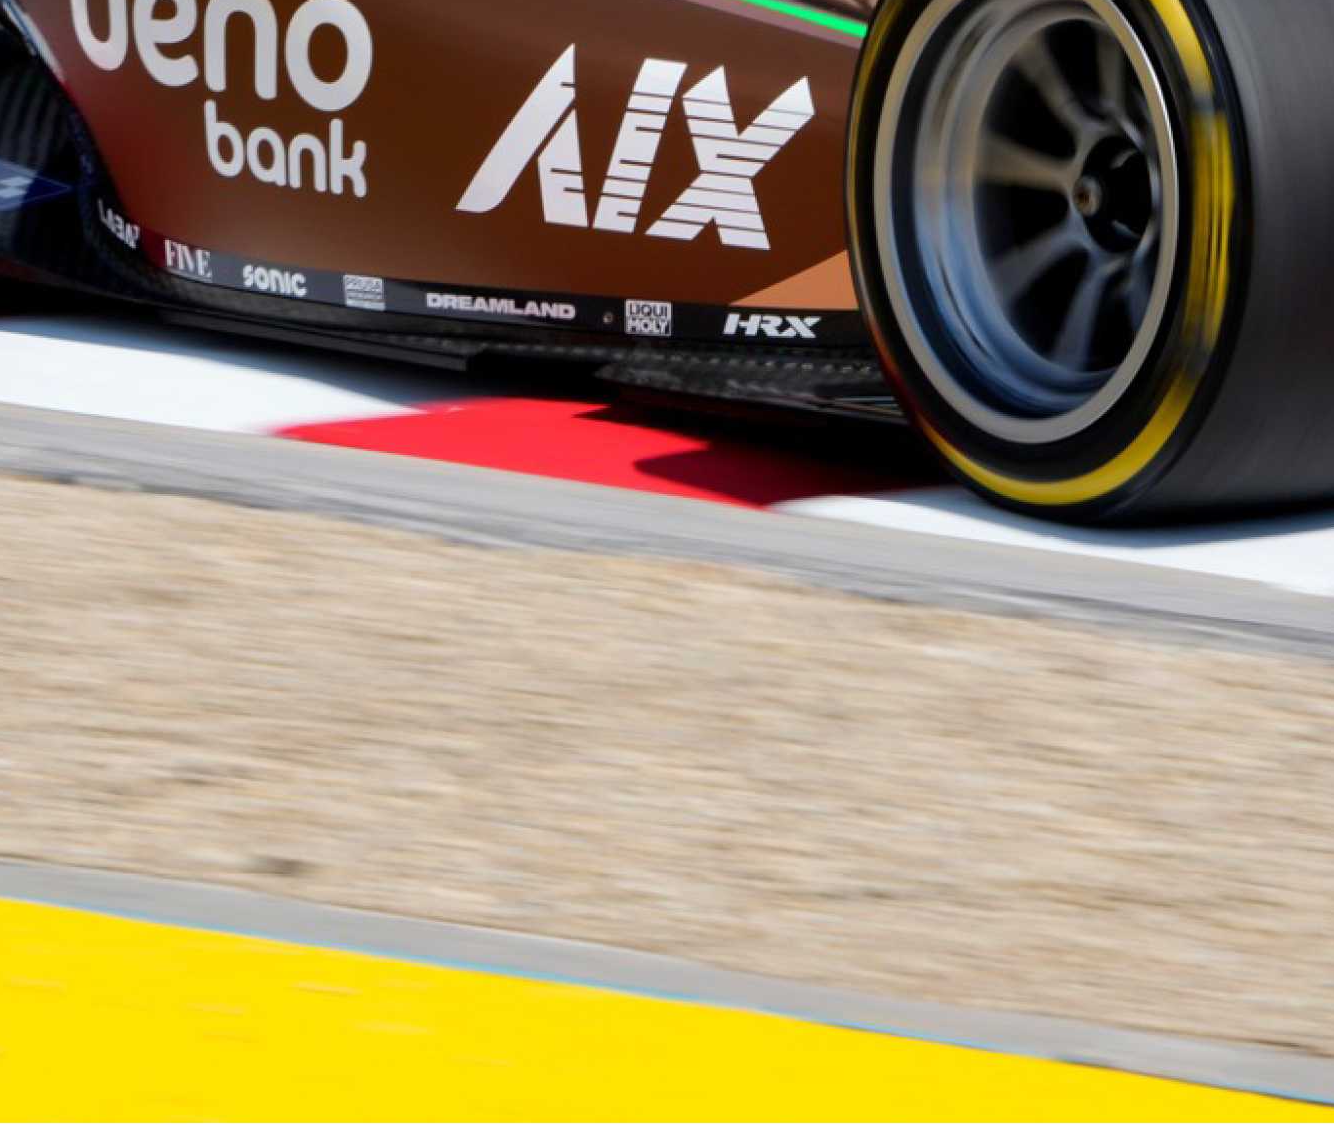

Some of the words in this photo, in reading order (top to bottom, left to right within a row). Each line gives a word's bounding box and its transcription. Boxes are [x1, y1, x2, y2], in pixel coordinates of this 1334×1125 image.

[203, 98, 367, 198] bank
[455, 42, 817, 251] AIX
[425, 291, 577, 321] DREAMLAND
[722, 311, 822, 339] HRX
